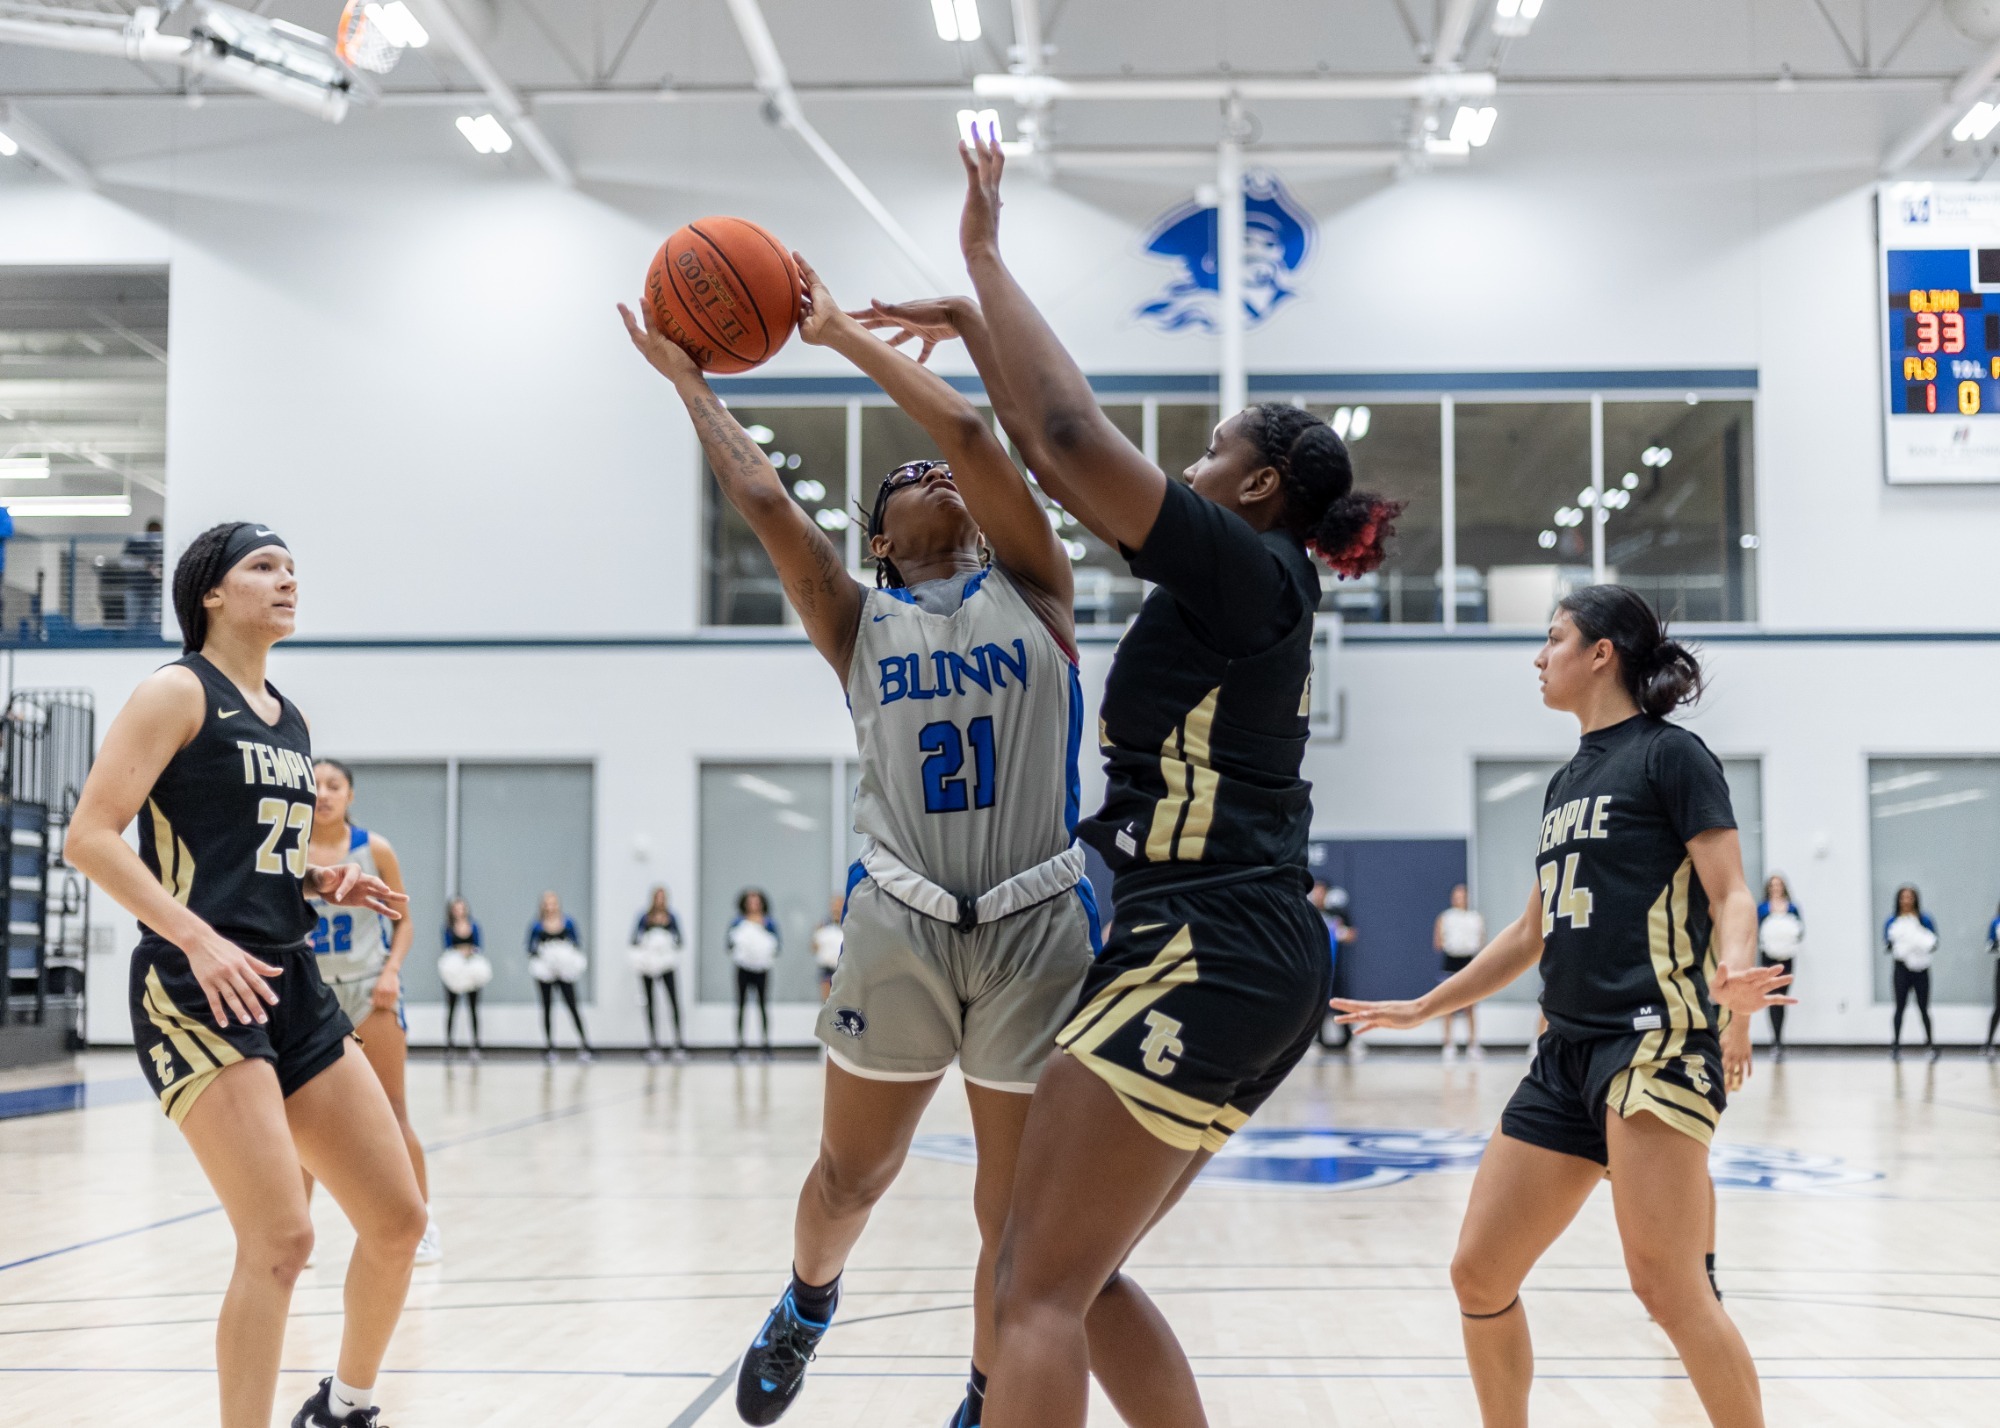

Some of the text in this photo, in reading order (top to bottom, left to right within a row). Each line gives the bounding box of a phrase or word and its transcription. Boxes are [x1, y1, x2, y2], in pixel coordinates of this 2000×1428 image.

[649, 269, 714, 364] SPALDING
[678, 252, 744, 343] TF-1000
[1916, 312, 1966, 354] 33
[1926, 380, 1981, 415] 1 0
[878, 638, 1027, 706] BLINN
[236, 740, 317, 794] TEMPL
[918, 715, 996, 814] 21
[255, 797, 313, 879] 23
[1539, 852, 1593, 939] 24
[310, 913, 353, 954] 22
[1139, 1009, 1184, 1077] TC
[1640, 1006, 1652, 1015] M
